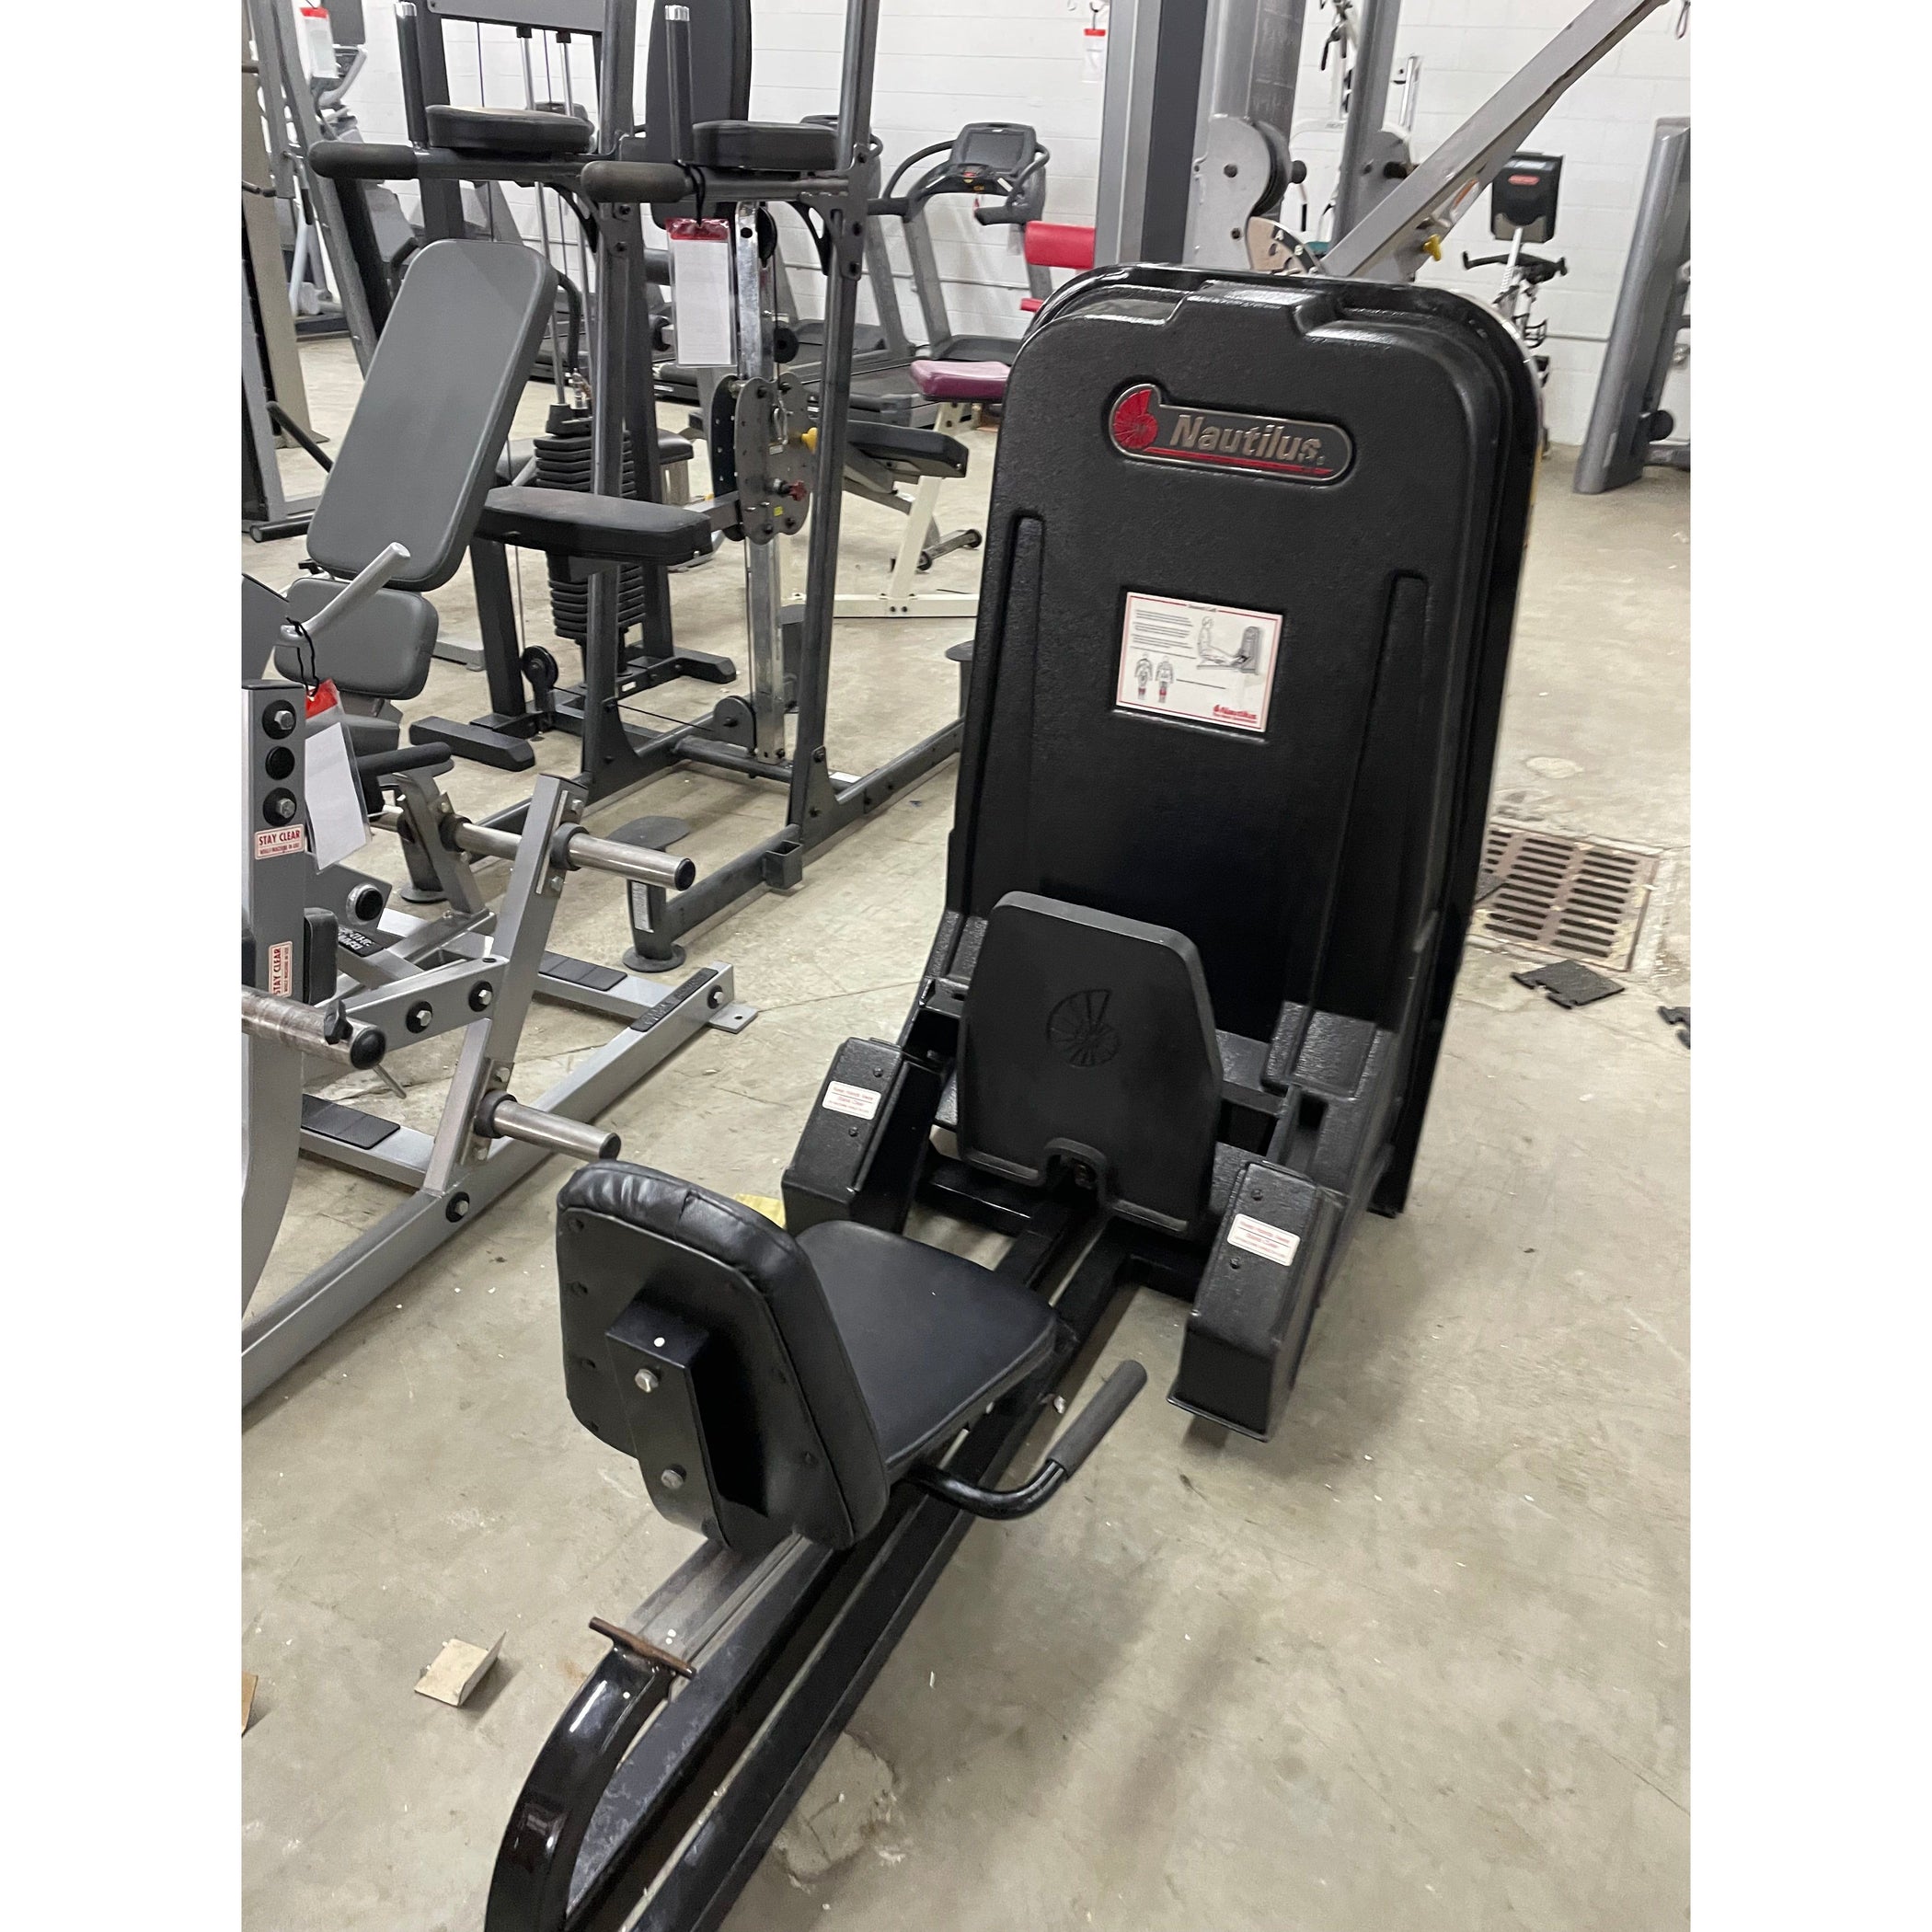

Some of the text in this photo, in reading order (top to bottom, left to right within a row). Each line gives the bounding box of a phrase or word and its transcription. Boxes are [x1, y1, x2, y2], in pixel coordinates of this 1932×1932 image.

[1169, 414, 1322, 463] Nautilus
[259, 830, 300, 846] STAY CLEAR
[273, 949, 282, 995] STAY CLEAR
